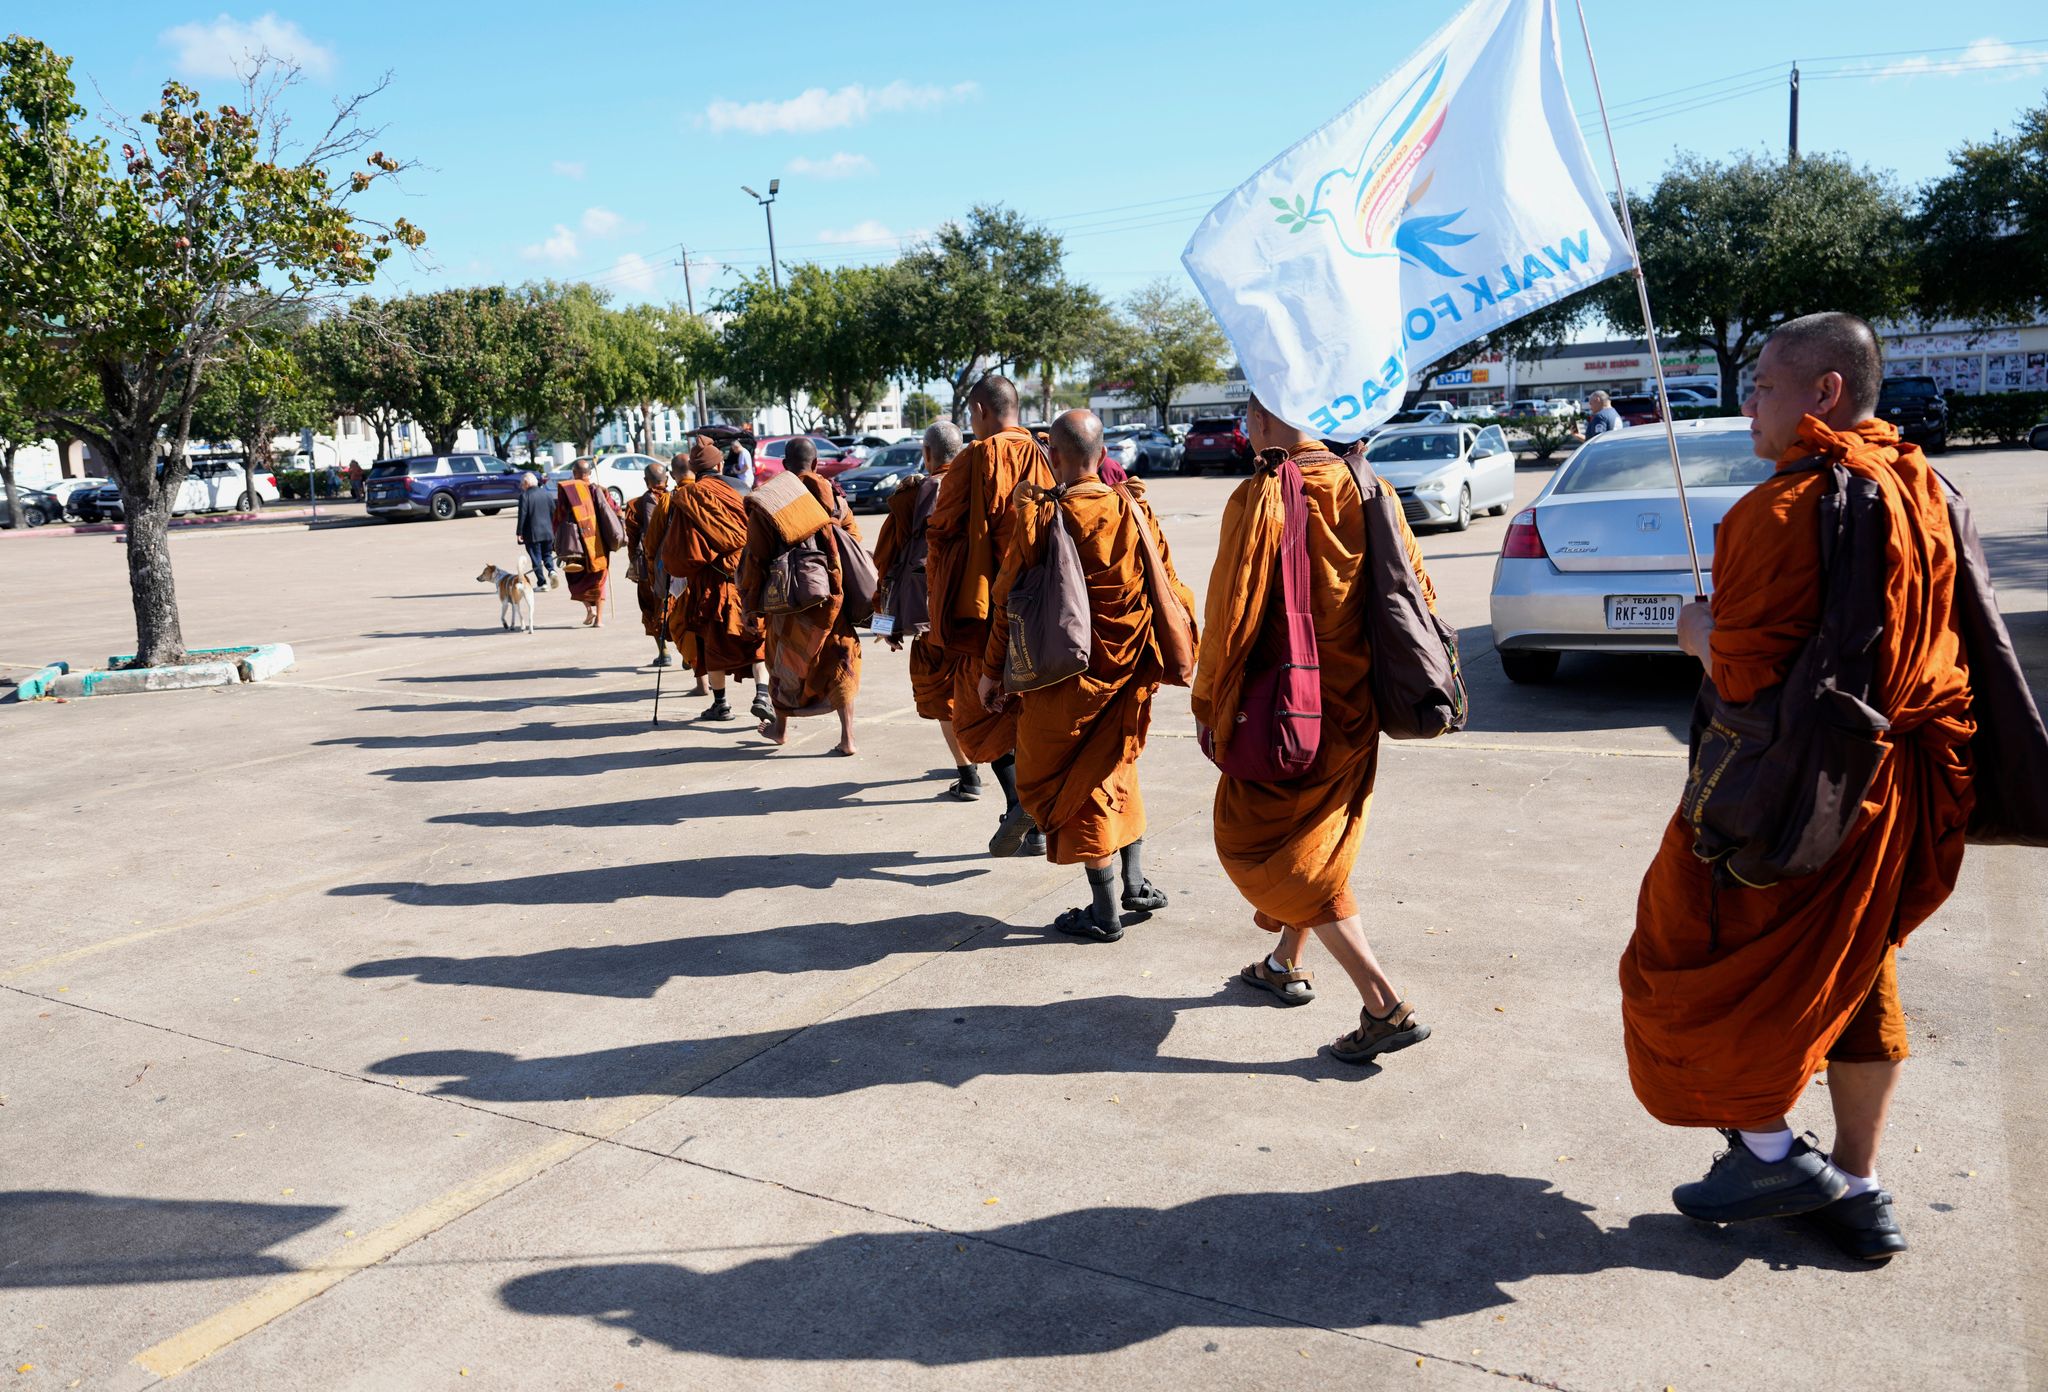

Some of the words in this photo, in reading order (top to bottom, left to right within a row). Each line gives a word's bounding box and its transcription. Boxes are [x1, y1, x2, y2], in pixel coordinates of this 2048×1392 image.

[1438, 371, 1471, 384] TOFU
[1615, 606, 1638, 621] RKF
[1644, 606, 1675, 621] 9109
